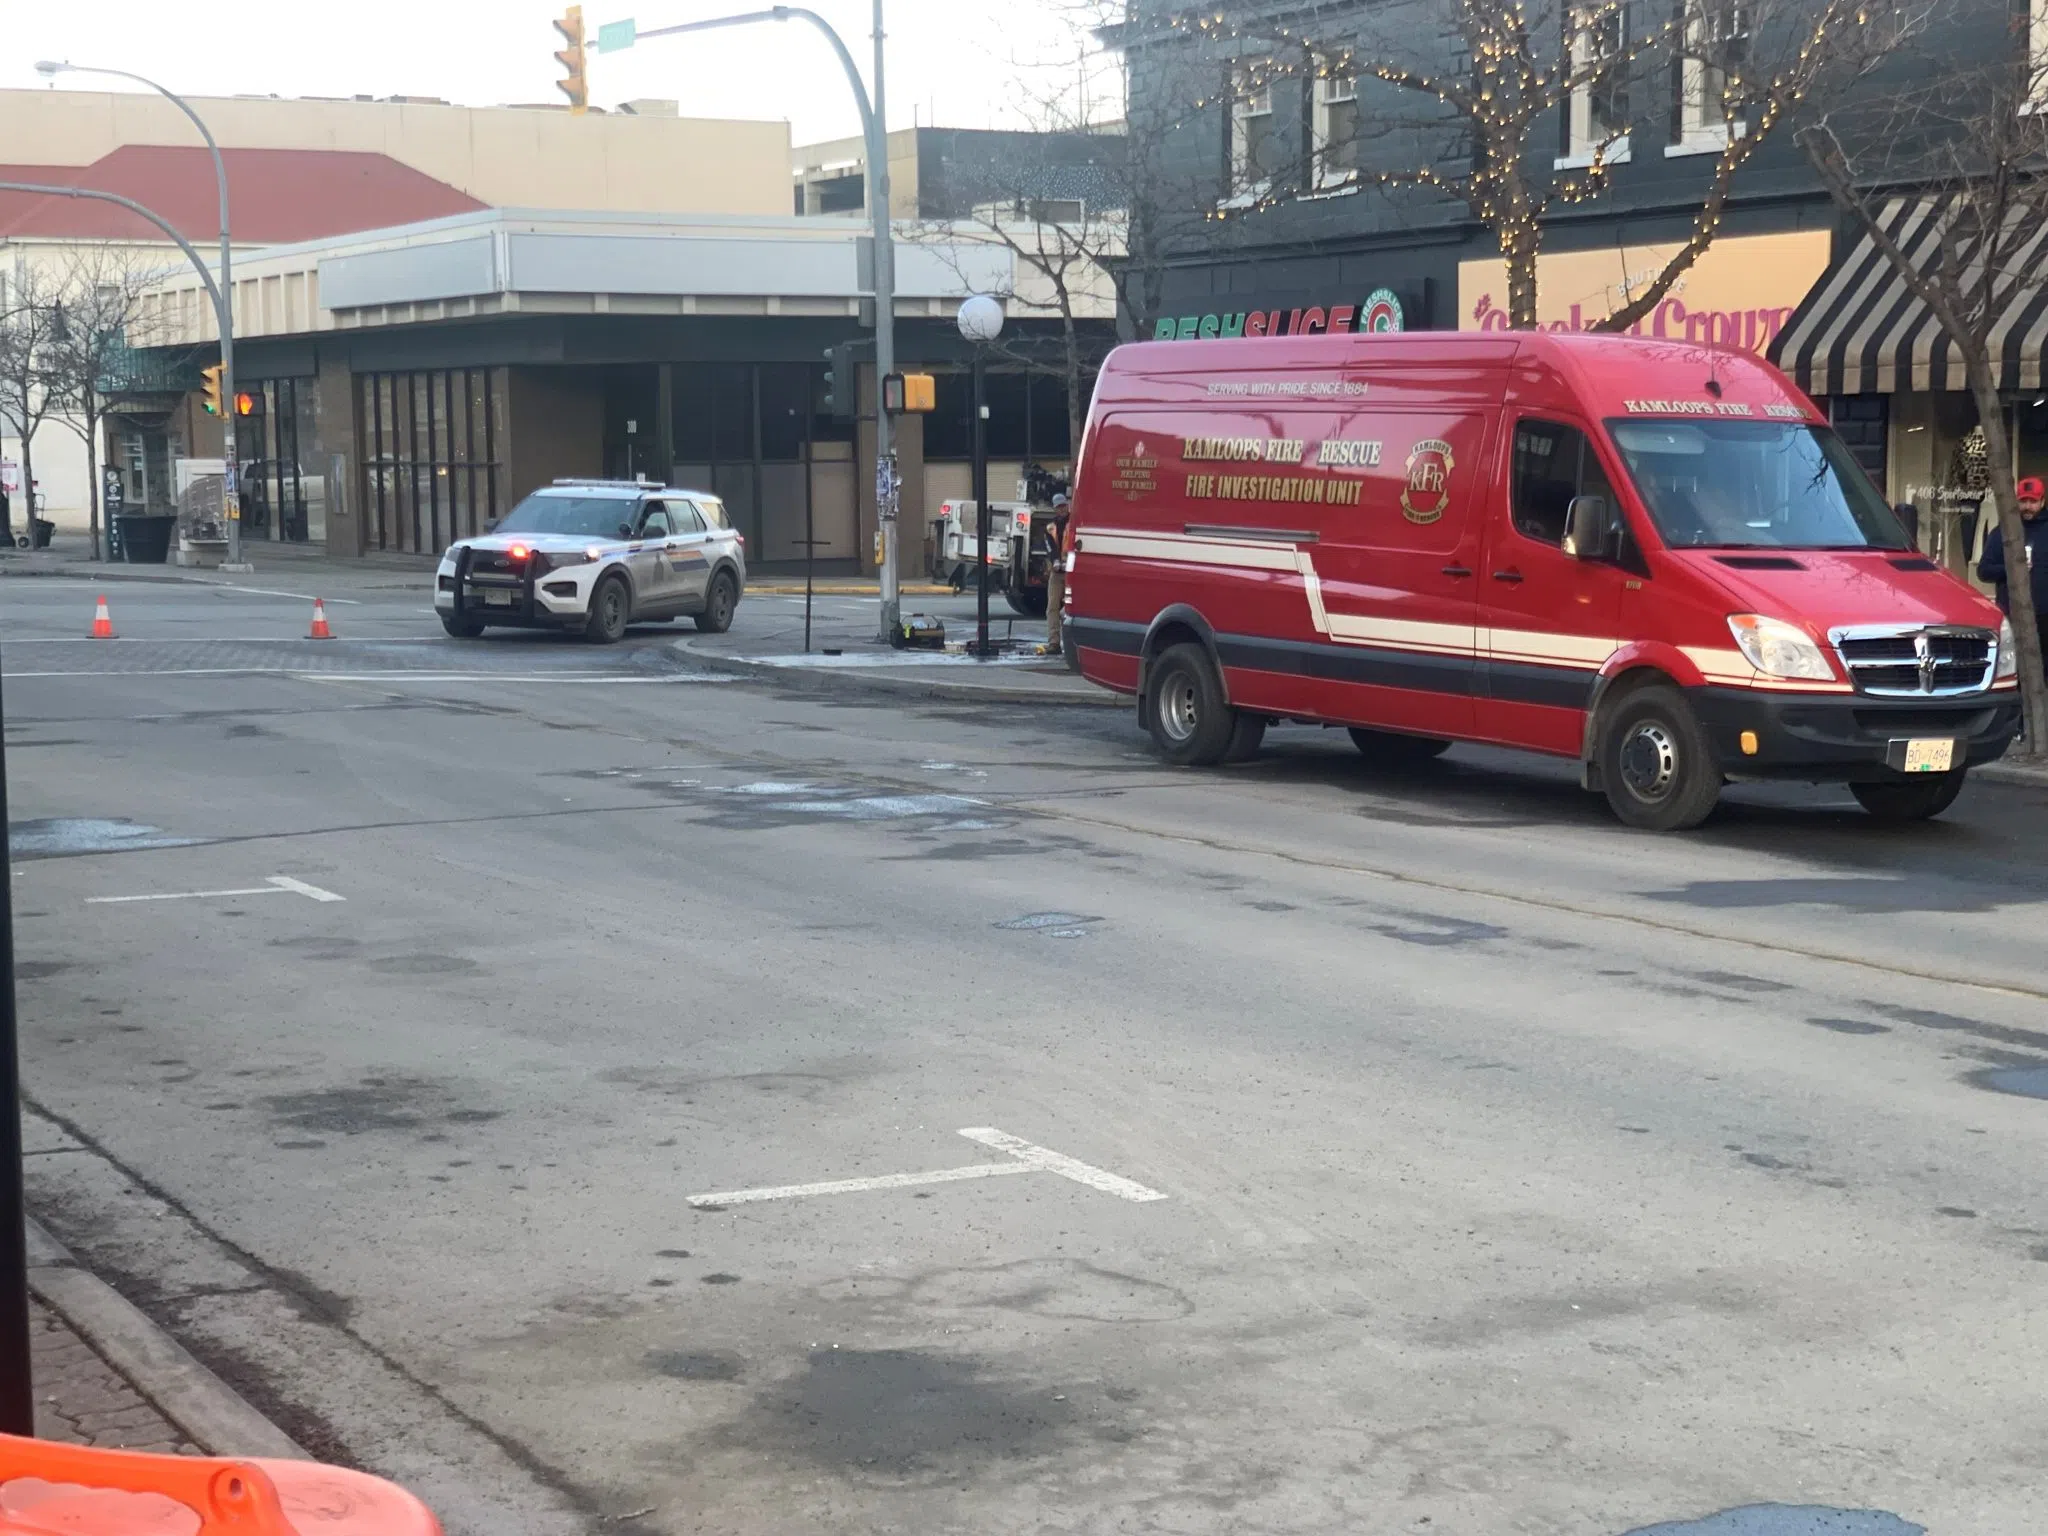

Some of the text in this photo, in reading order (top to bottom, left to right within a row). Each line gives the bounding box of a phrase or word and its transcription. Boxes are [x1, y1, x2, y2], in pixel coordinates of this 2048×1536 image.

[1361, 288, 1403, 325] FRESHSLICE
[1207, 382, 1369, 396] SERVING WITH PRIDE SINCE 1884
[1623, 400, 1715, 416] KAMLOOPS
[1714, 402, 1753, 416] FIRE
[1182, 437, 1383, 466] KAMLOOPS FIRE RESCUE
[1185, 474, 1364, 505] FIRE INVESTIGATION UNIT
